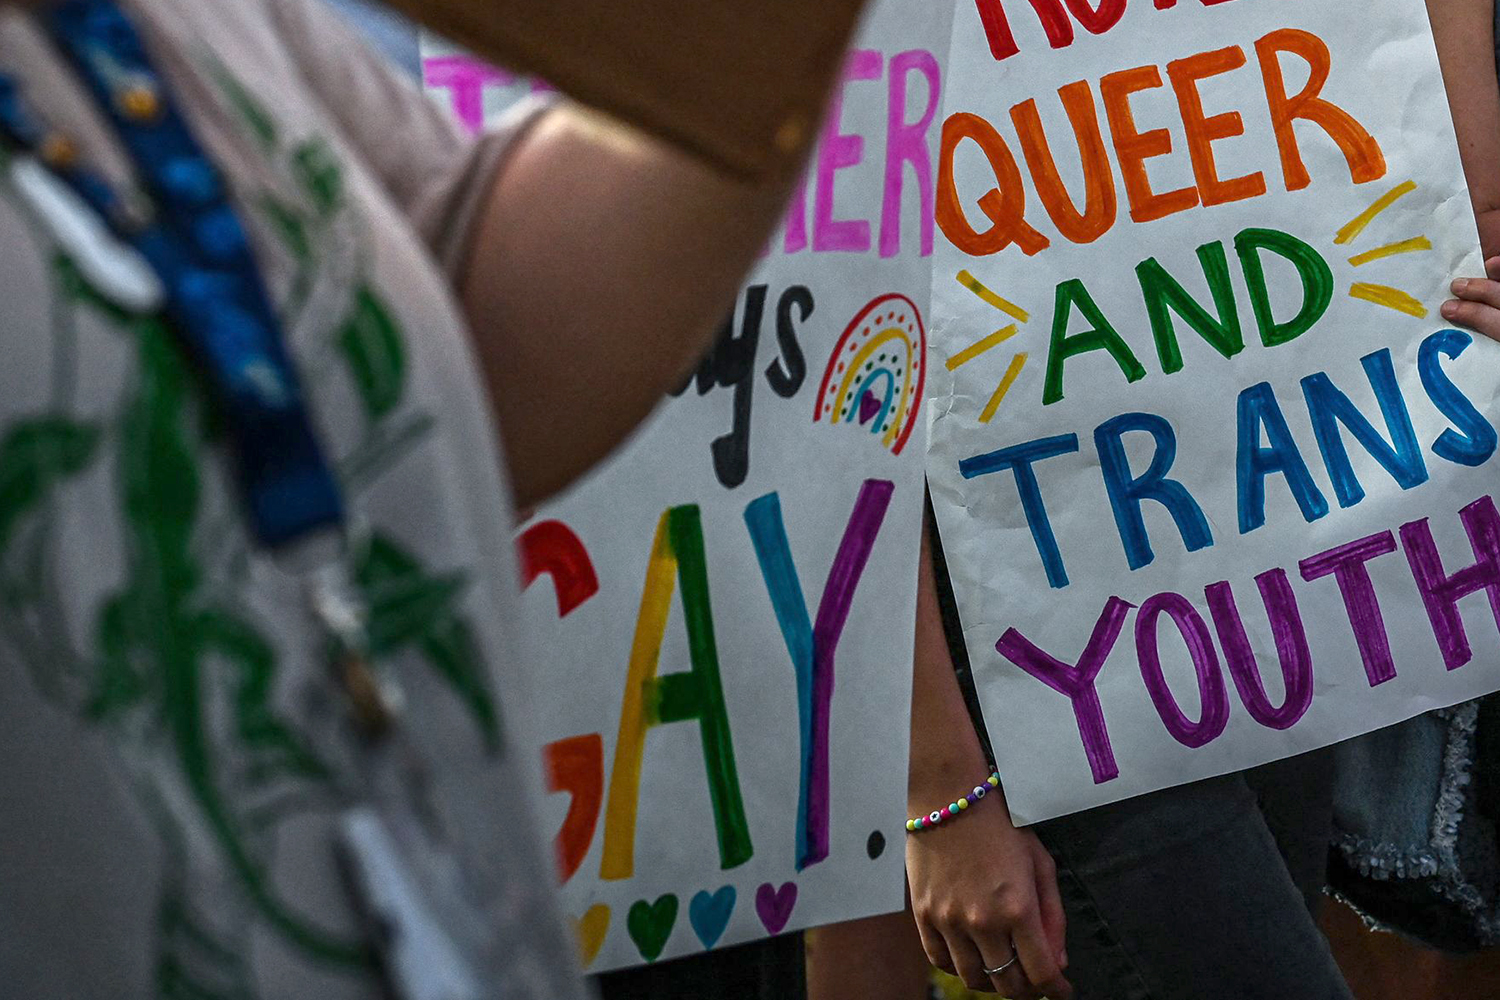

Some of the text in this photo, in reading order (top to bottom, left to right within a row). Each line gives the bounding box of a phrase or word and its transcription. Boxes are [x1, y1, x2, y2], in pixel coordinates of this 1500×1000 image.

[934, 27, 1388, 257] QUEER
[1042, 227, 1335, 406] AND
[958, 328, 1498, 589] TRANS
